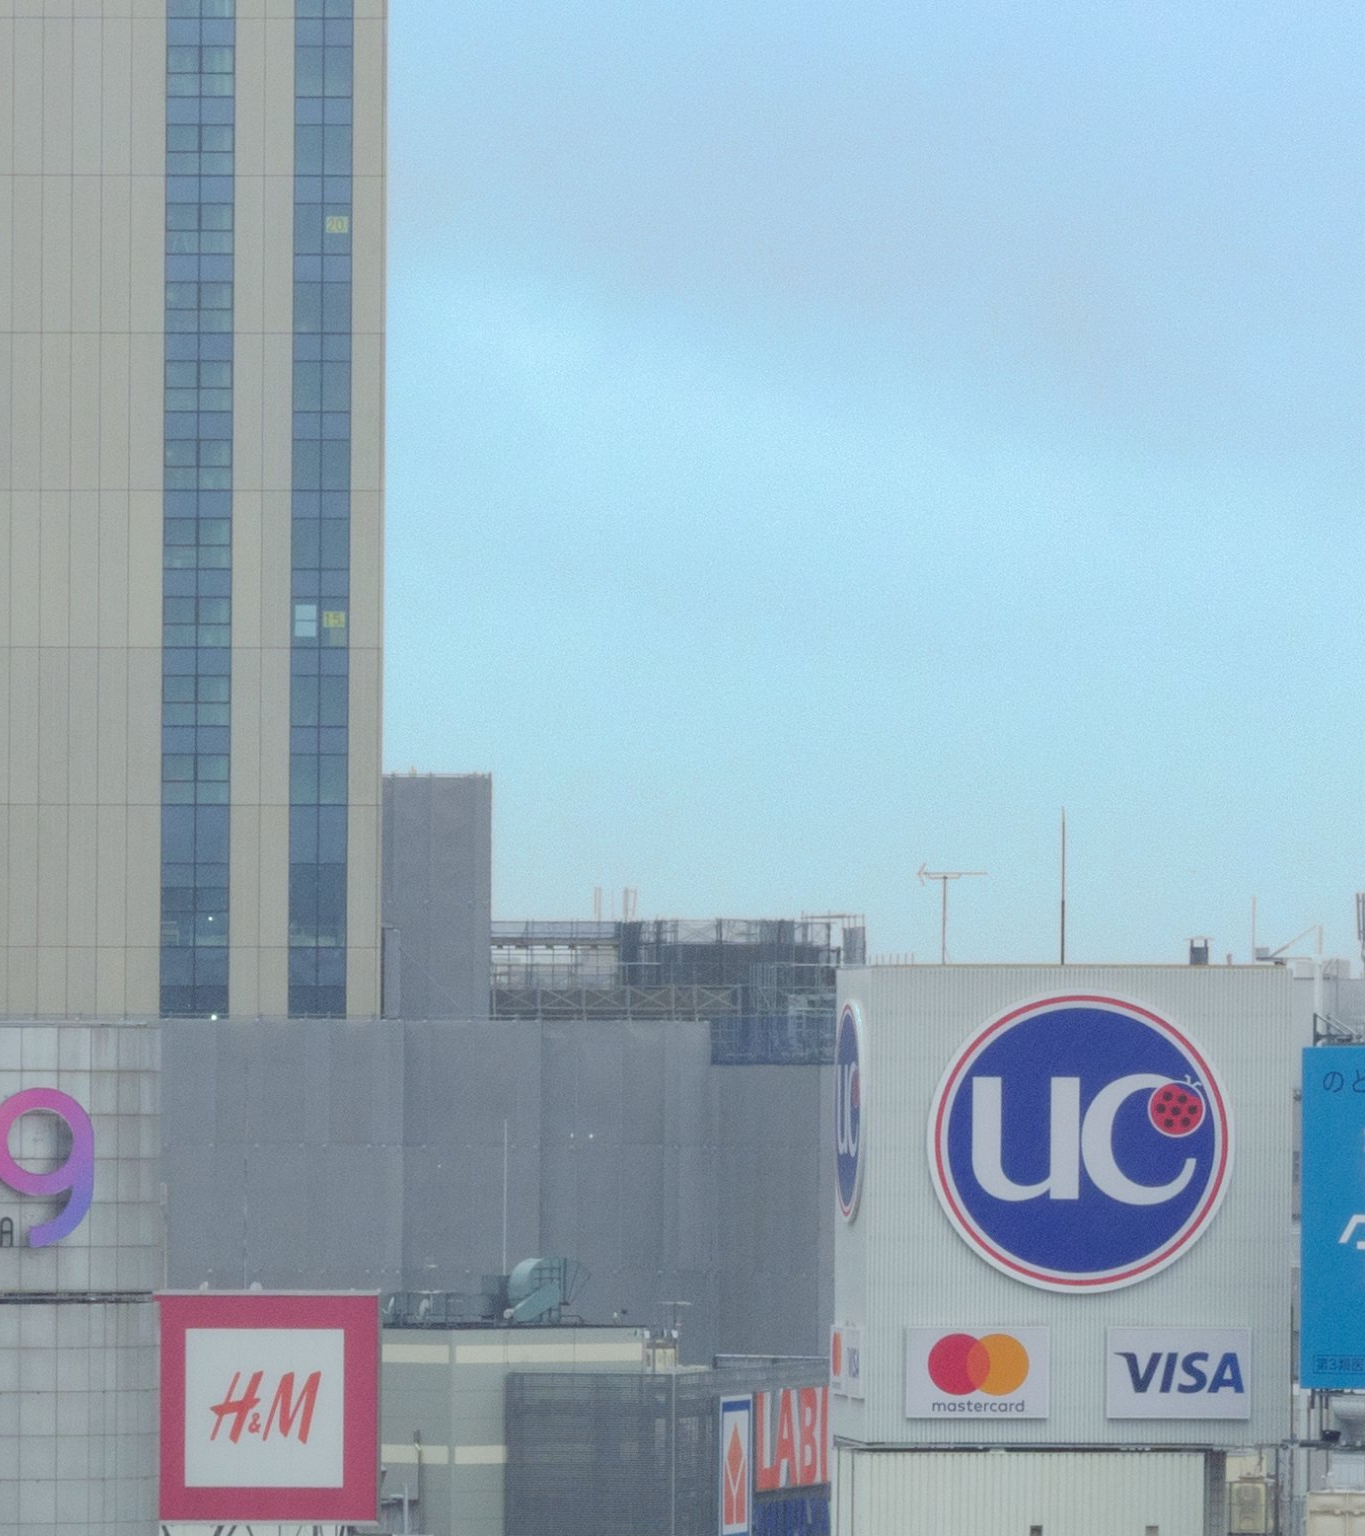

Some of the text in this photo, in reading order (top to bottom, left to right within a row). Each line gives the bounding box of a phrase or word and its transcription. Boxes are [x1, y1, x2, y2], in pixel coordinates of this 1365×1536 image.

[1114, 1350, 1245, 1394] VISA
[209, 1370, 322, 1445] H&M
[932, 1398, 1026, 1415] mastercard
